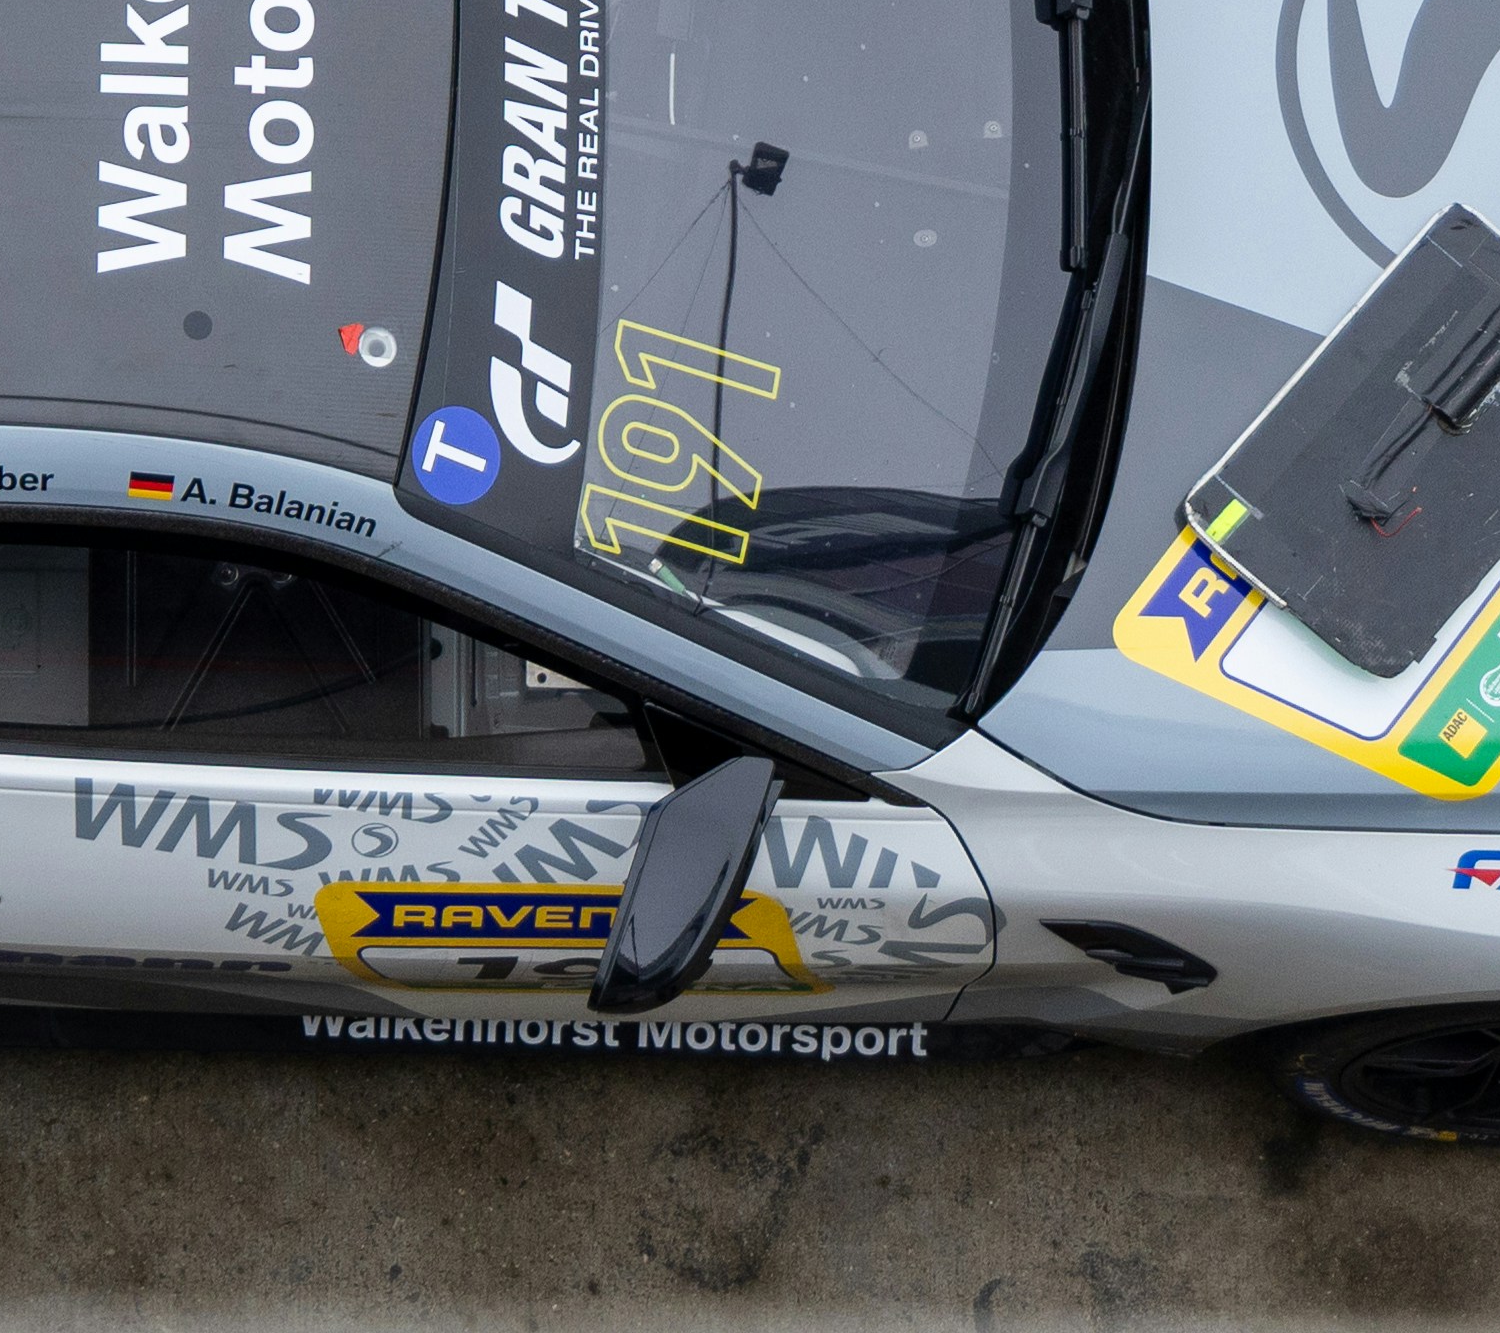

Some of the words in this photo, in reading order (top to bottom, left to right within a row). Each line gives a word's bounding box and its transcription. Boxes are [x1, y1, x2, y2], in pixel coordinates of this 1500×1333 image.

[499, 37, 569, 259] GRAN
[576, 88, 599, 180] REAL
[573, 190, 597, 261] THE
[421, 419, 487, 473] T
[580, 318, 781, 565] 191
[179, 476, 217, 507] A.
[227, 482, 379, 539] Balanian
[1442, 711, 1468, 741] ADAC
[74, 776, 334, 871] WMS
[457, 796, 540, 860] WMS
[207, 868, 295, 897] WMS
[816, 897, 886, 910] WMS
[224, 902, 325, 957] WM
[392, 904, 620, 929] RAVEN
[301, 1014, 620, 1049] Walkenhorst
[637, 1021, 929, 1061] Motorsport
